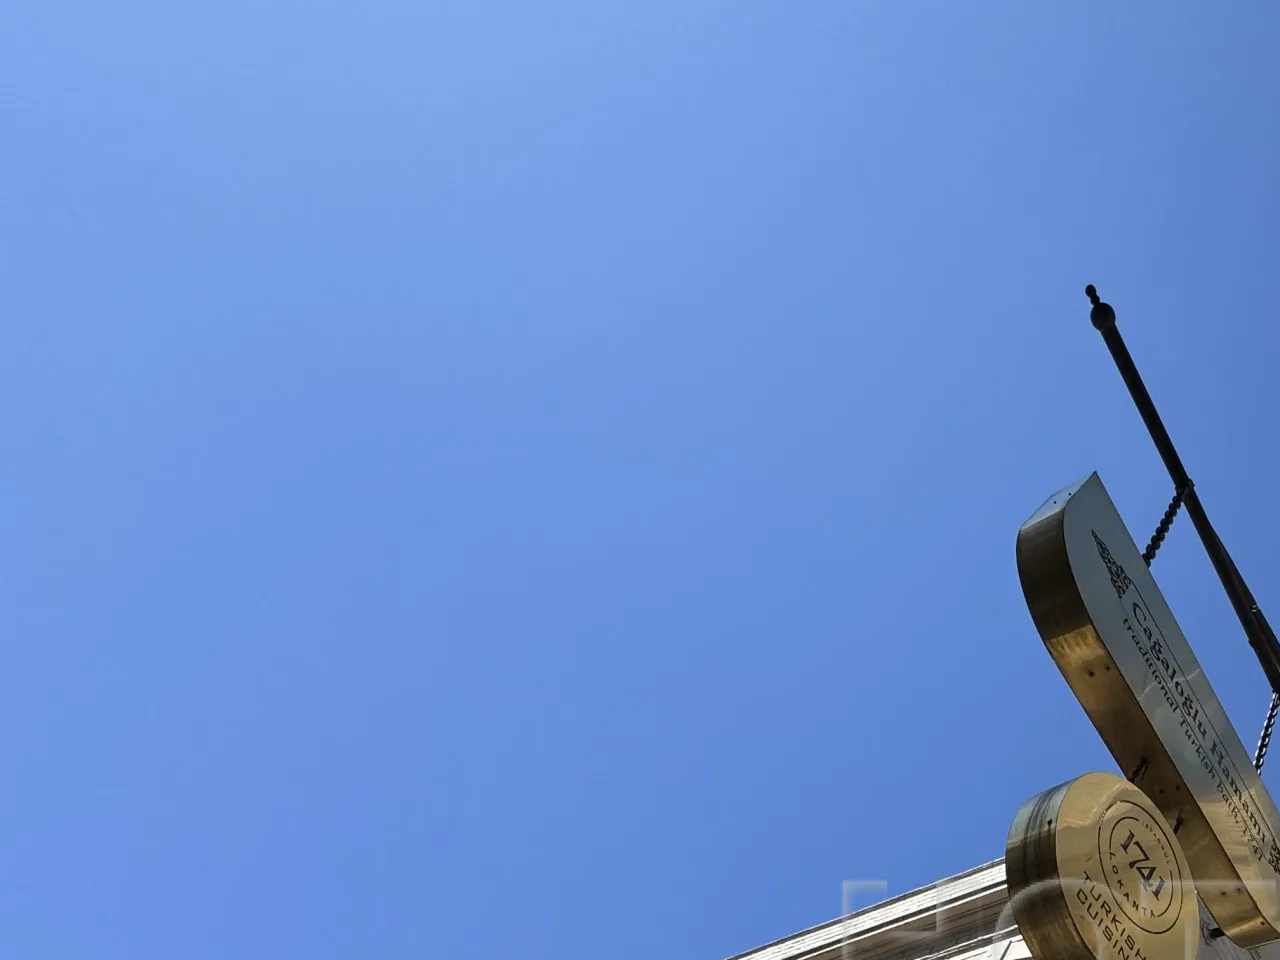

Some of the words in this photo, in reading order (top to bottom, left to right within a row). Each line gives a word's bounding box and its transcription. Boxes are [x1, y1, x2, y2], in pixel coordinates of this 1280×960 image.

[1123, 618, 1178, 712] traditional
[1179, 715, 1216, 780] Turkish
[1132, 602, 1207, 740] Cağaloğlu
[1109, 851, 1157, 918] LOKANTA
[1120, 828, 1166, 901] 1741
